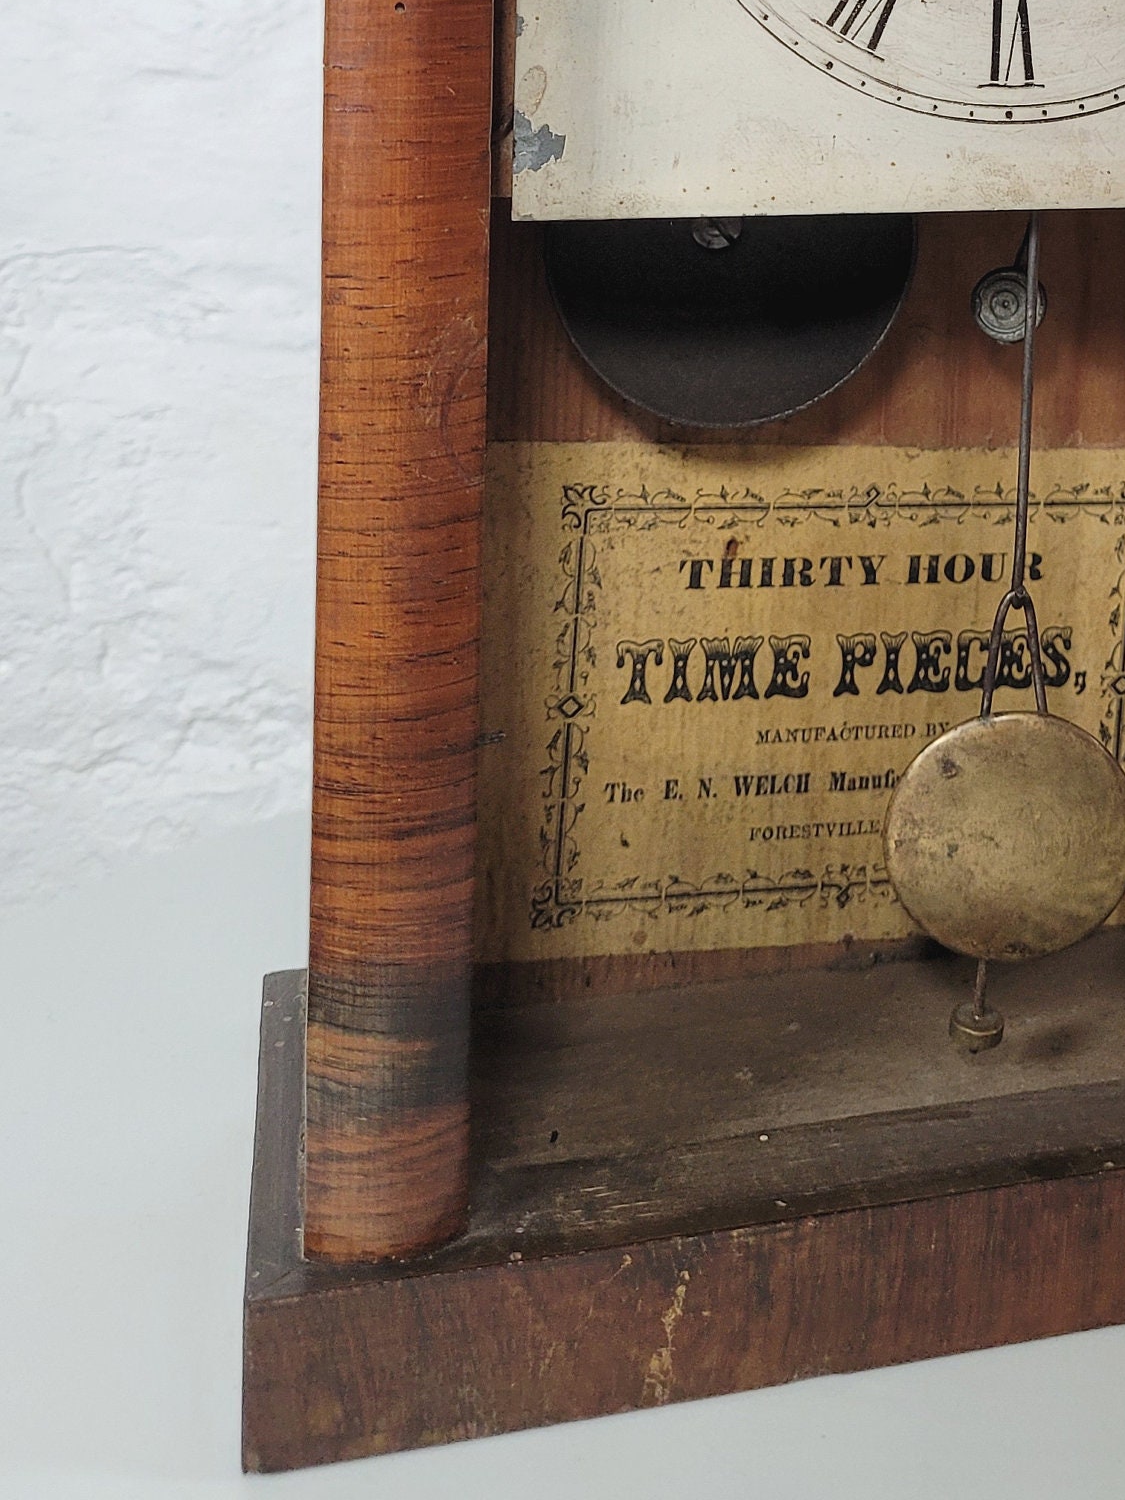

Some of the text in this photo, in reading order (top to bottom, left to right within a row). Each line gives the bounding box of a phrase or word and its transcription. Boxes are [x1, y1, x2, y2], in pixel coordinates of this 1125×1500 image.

[679, 552, 1045, 591] THIRTY HOUR
[615, 626, 1087, 706] TIME PIECES,
[756, 724, 916, 746] MANUFACTURED
[603, 782, 644, 803] The
[663, 779, 684, 800] E.
[697, 777, 718, 800] N.
[734, 771, 811, 797] WELCH
